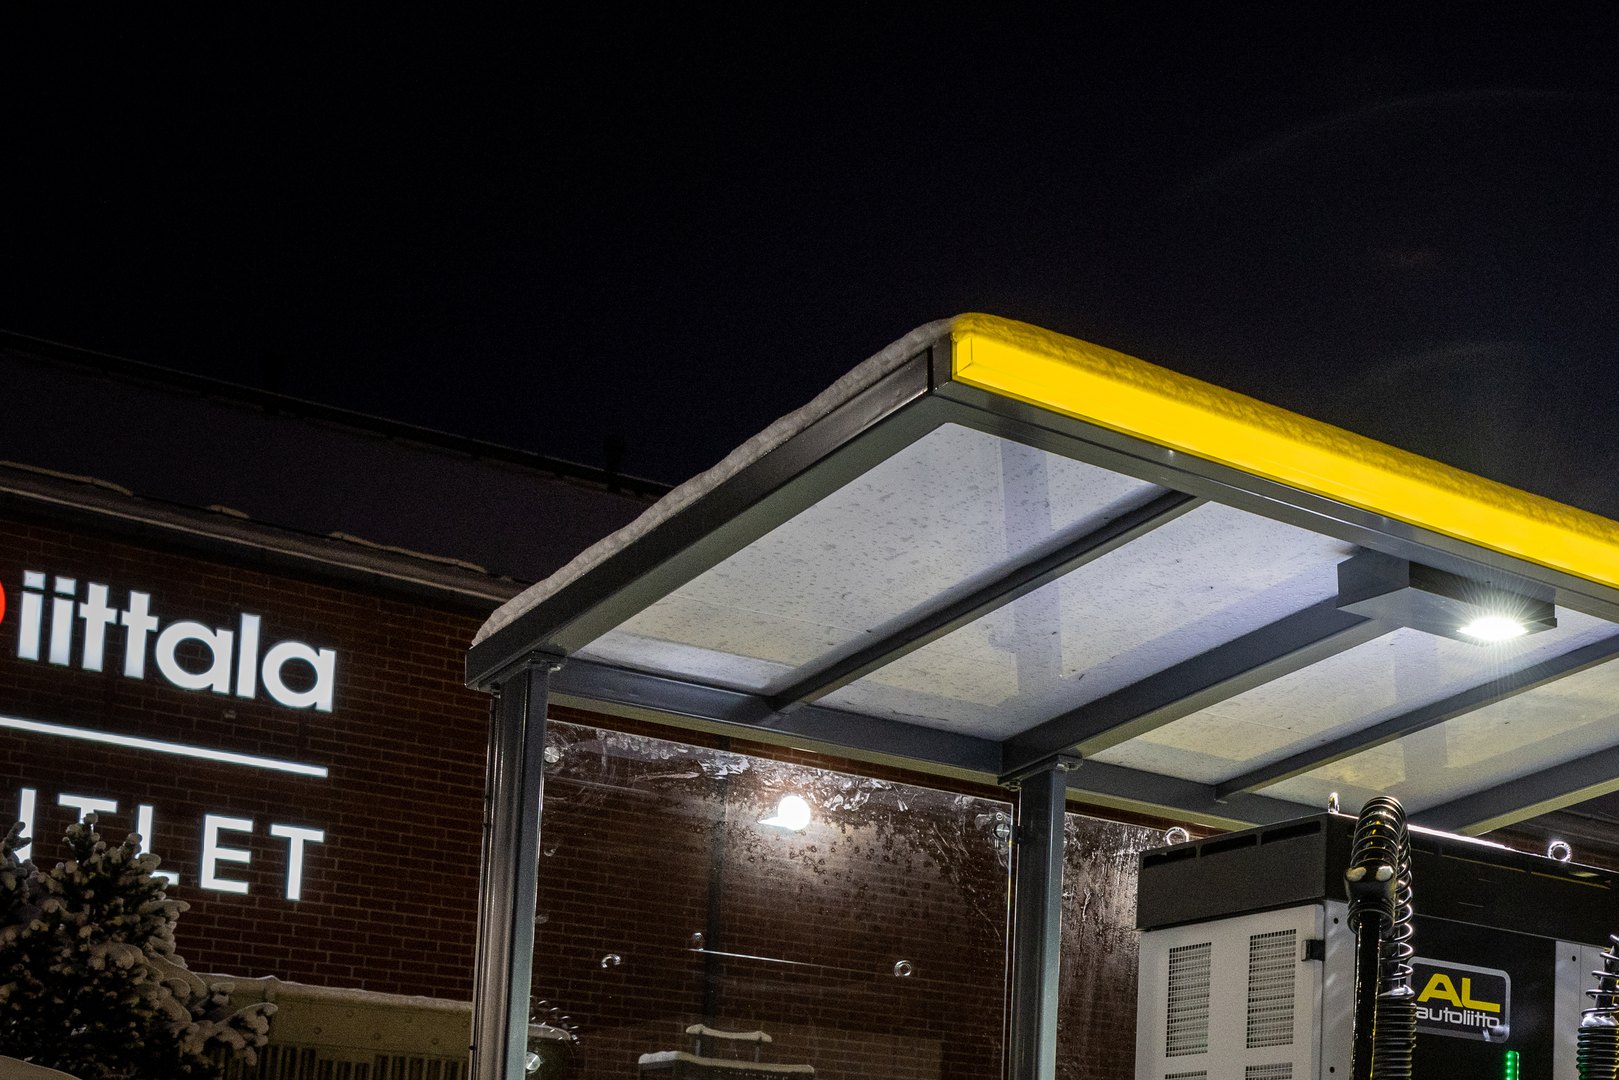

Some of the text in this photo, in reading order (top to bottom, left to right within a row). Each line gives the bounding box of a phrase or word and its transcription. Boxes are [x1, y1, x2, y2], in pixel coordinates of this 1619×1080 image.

[17, 569, 337, 713] iittala
[1417, 973, 1501, 1013] AL
[1415, 1006, 1500, 1029] autoliitto
